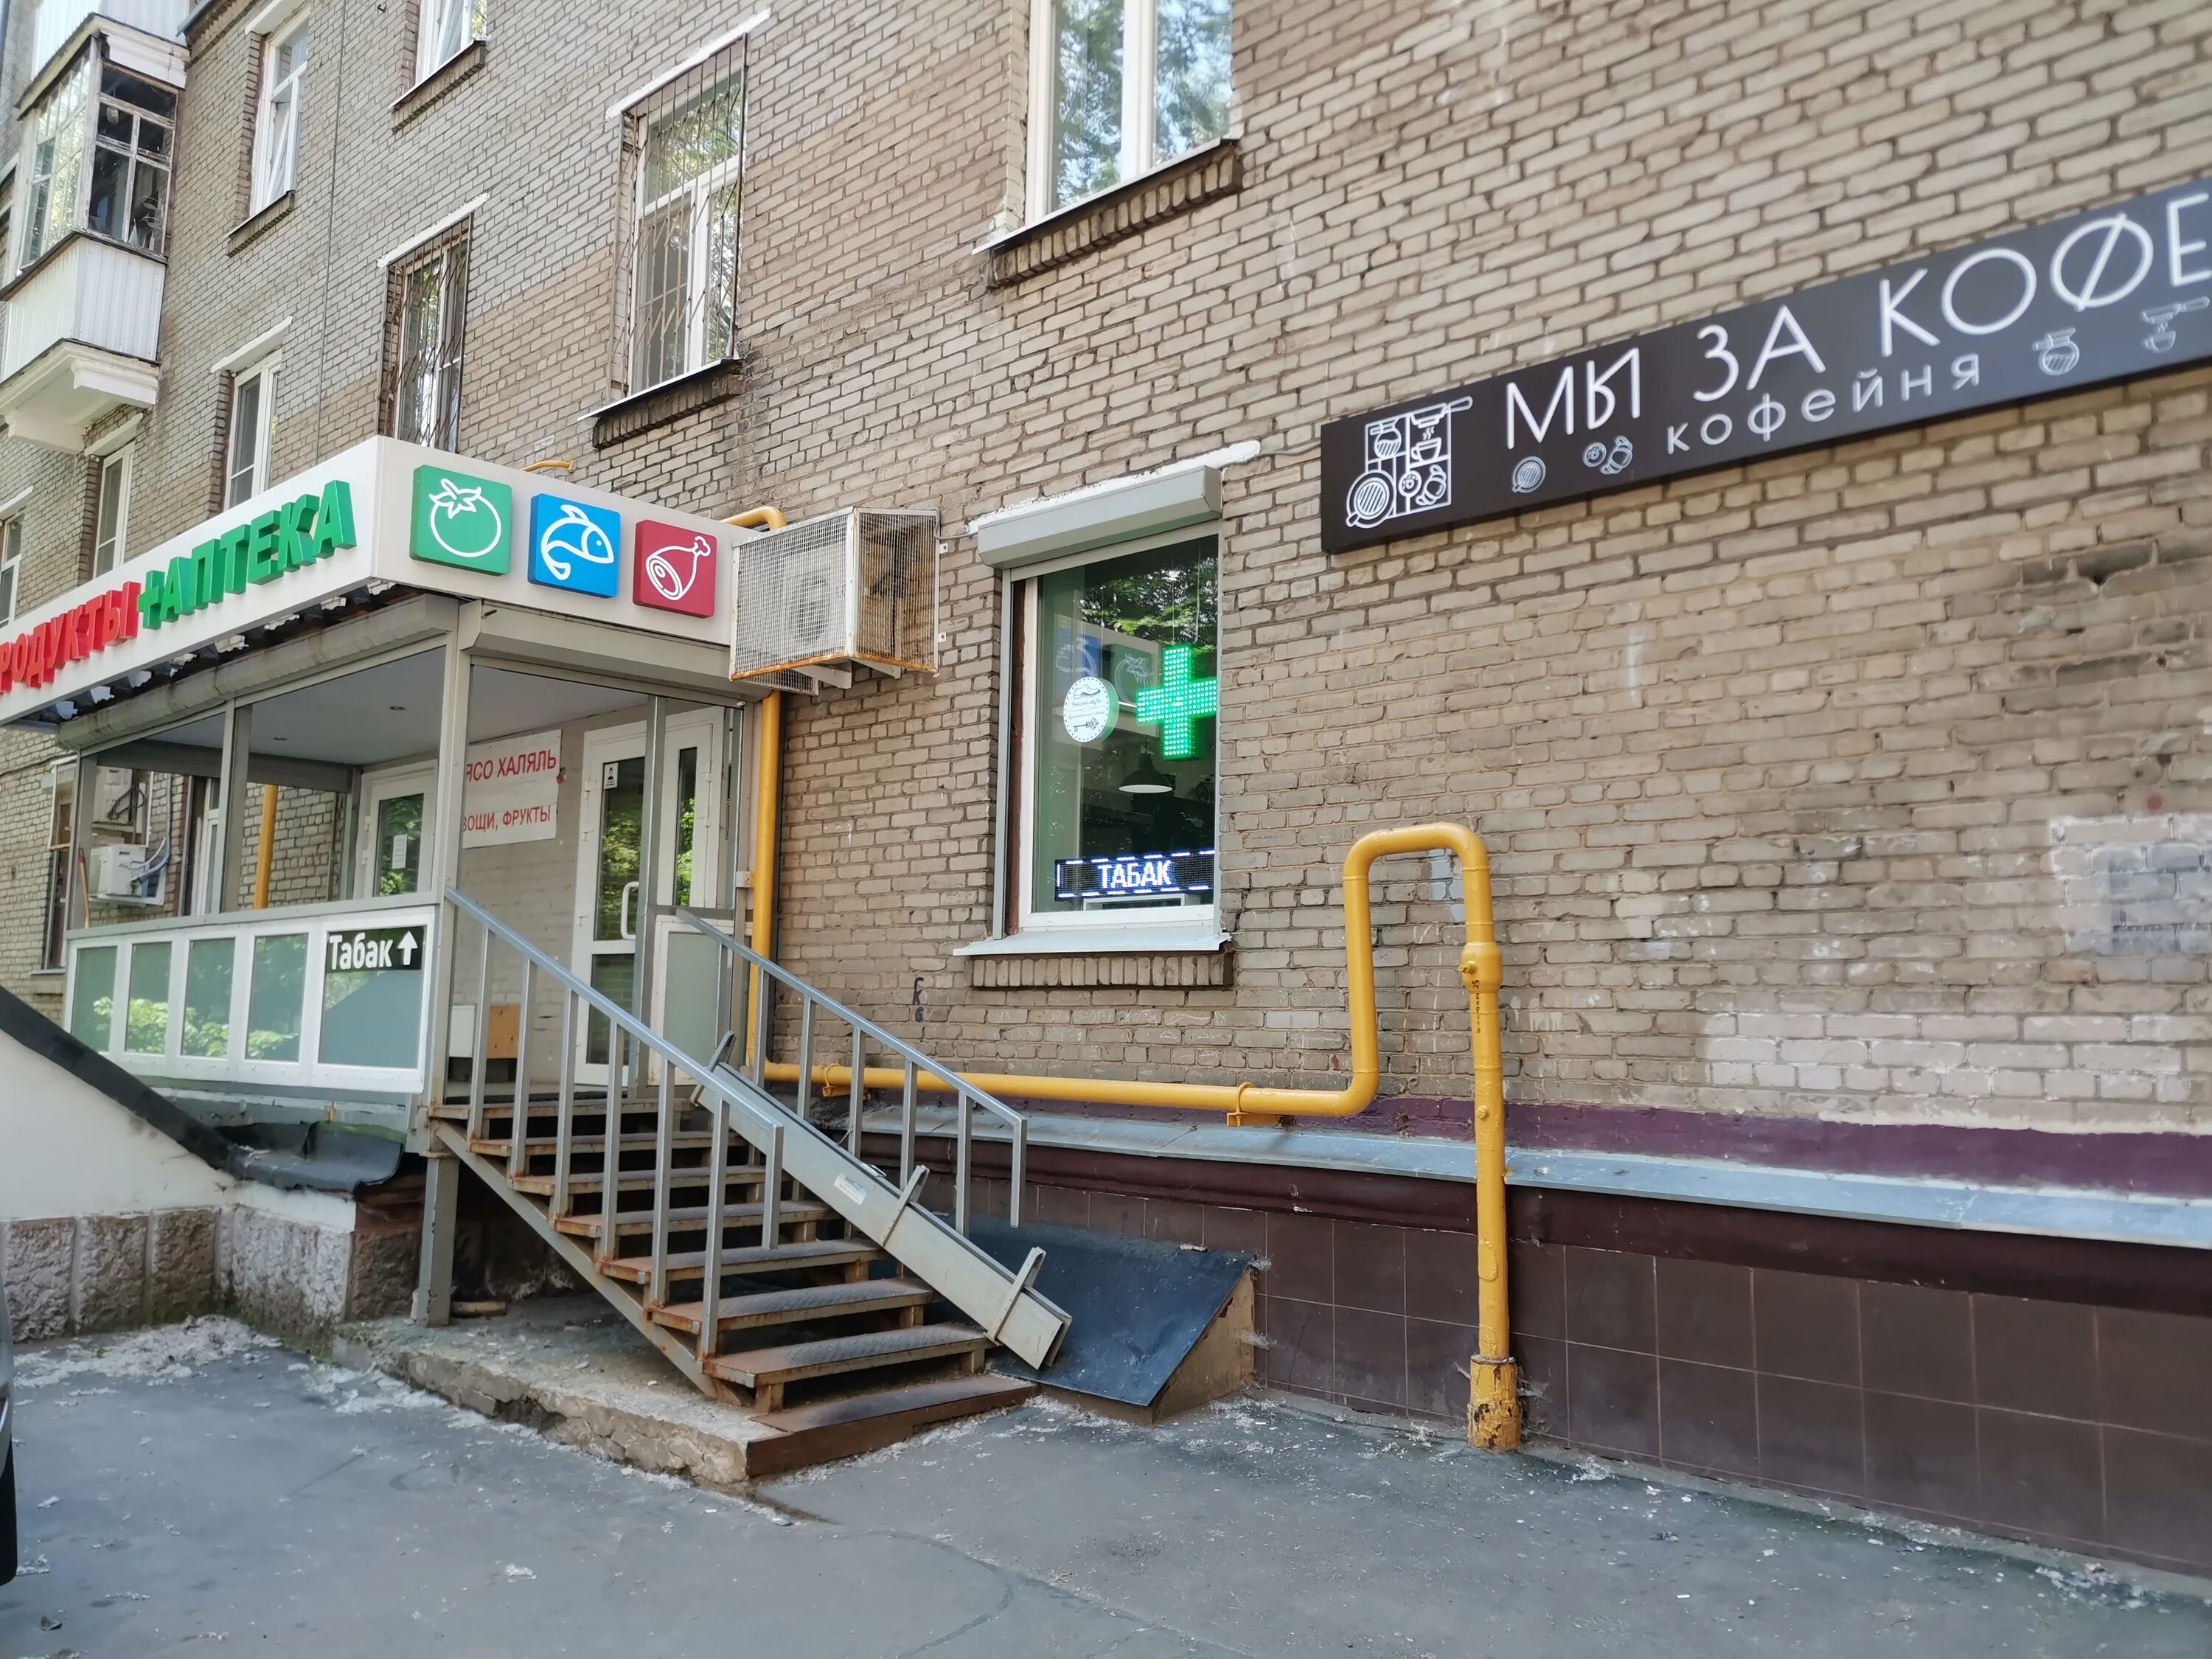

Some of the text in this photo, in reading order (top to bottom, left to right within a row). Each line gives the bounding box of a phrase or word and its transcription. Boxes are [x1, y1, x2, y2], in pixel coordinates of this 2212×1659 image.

[1693, 304, 1826, 403] ЗА
[1879, 192, 2212, 358] КОФЕ
[1667, 353, 1980, 455] кофейня
[497, 749, 557, 779] ХАЛЯЛЬ
[502, 805, 551, 826] ФРУКТЫ
[1097, 859, 1173, 889] ТАБАК
[329, 932, 394, 970] Табак
